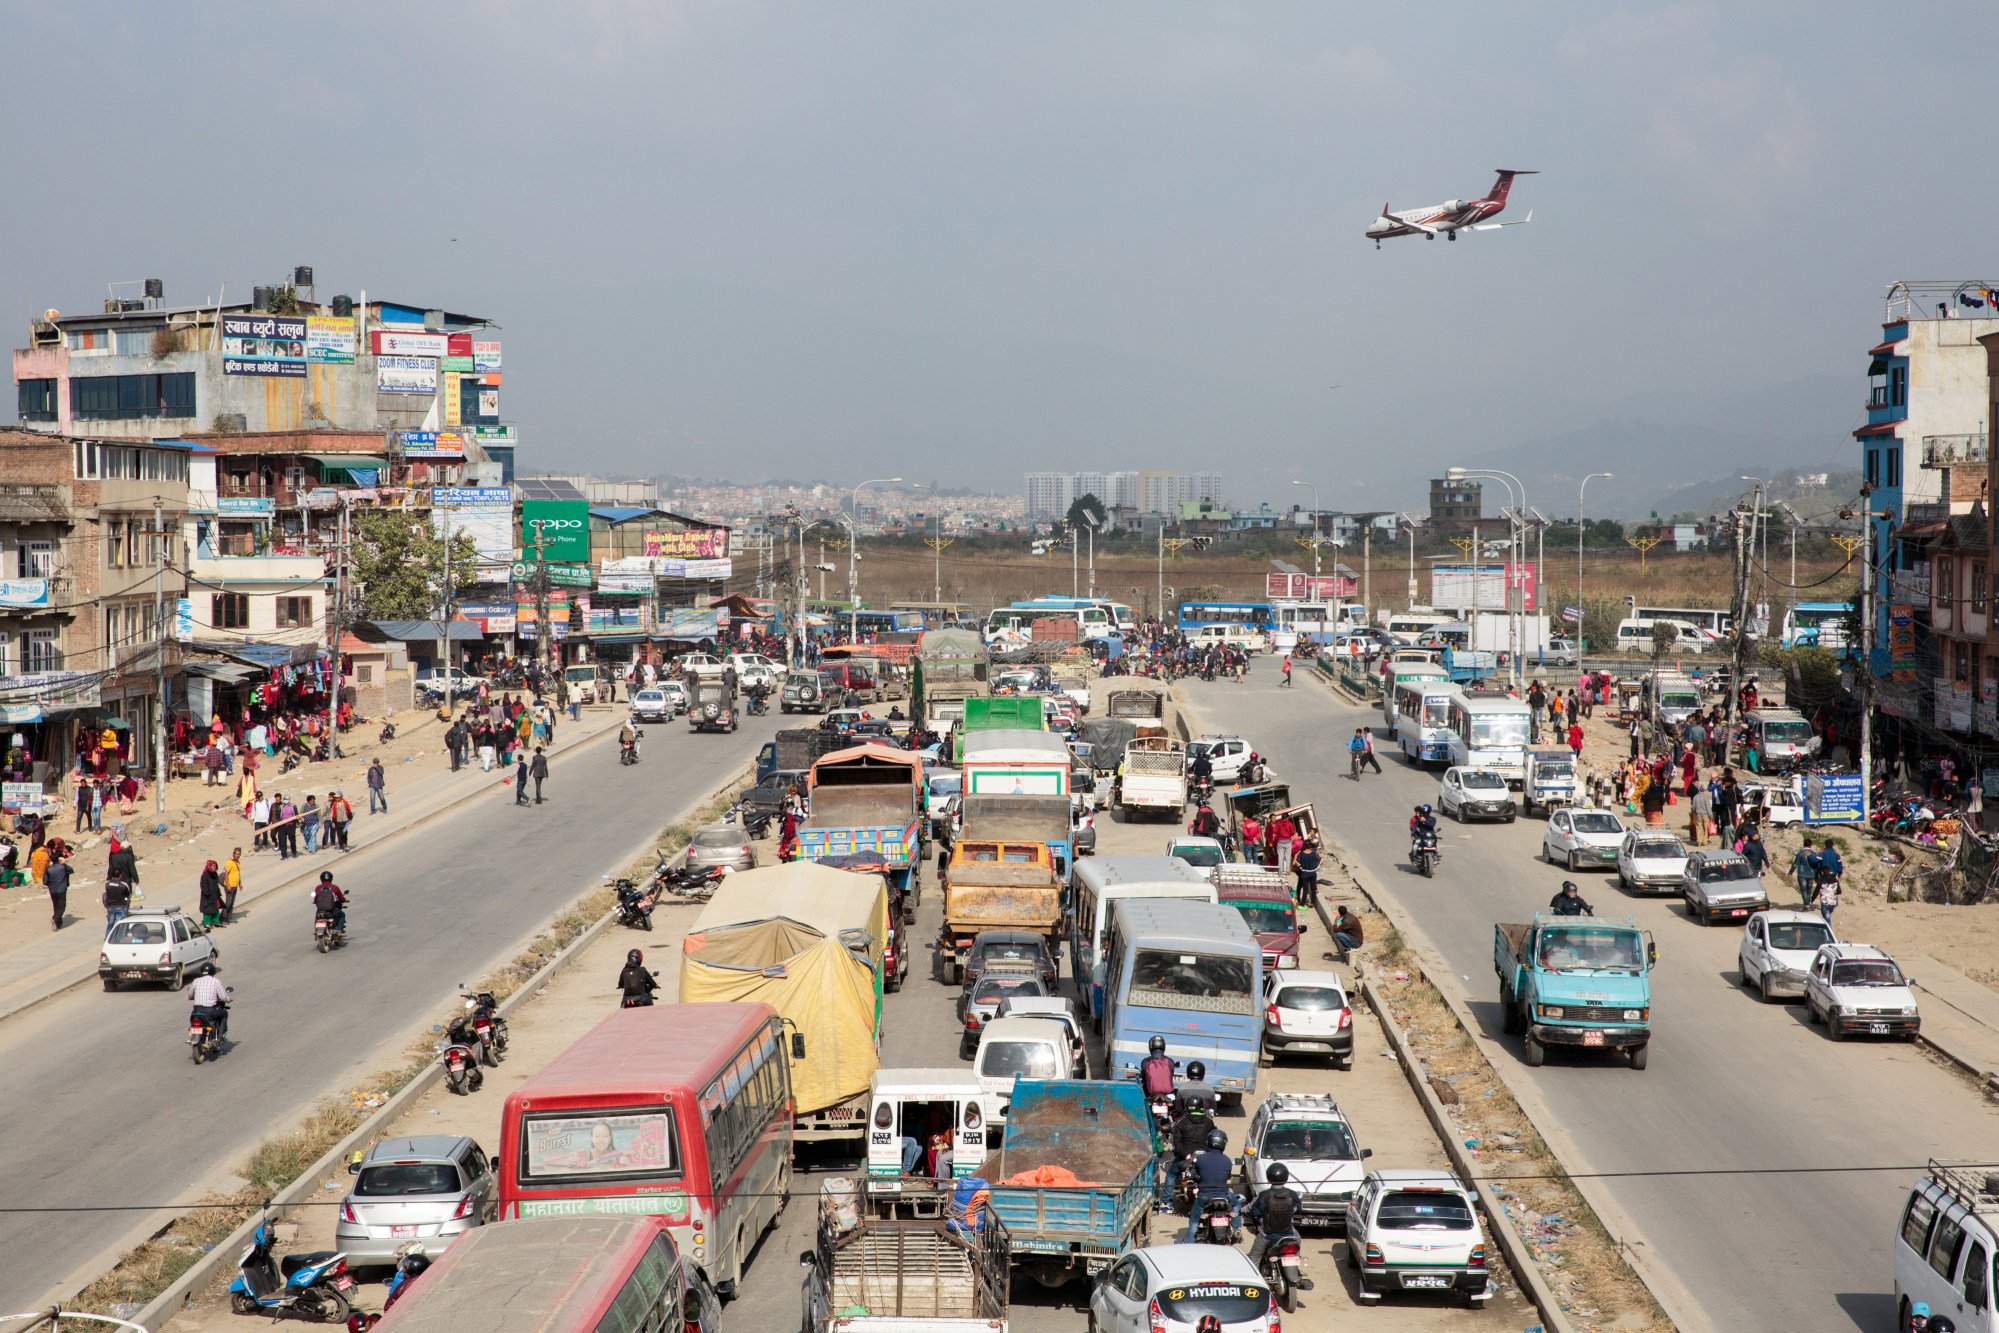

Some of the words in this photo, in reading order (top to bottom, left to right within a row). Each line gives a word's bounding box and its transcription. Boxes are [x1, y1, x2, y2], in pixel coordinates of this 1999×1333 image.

[379, 357, 396, 368] ZOOM
[397, 358, 420, 369] FITNESS
[420, 359, 436, 370] CLUB
[686, 532, 708, 541] Dance
[488, 606, 511, 615] Galaxy
[1710, 858, 1745, 867] SUZUKI
[538, 1132, 572, 1153] Burrst
[1189, 1288, 1241, 1298] HYUNDAI
